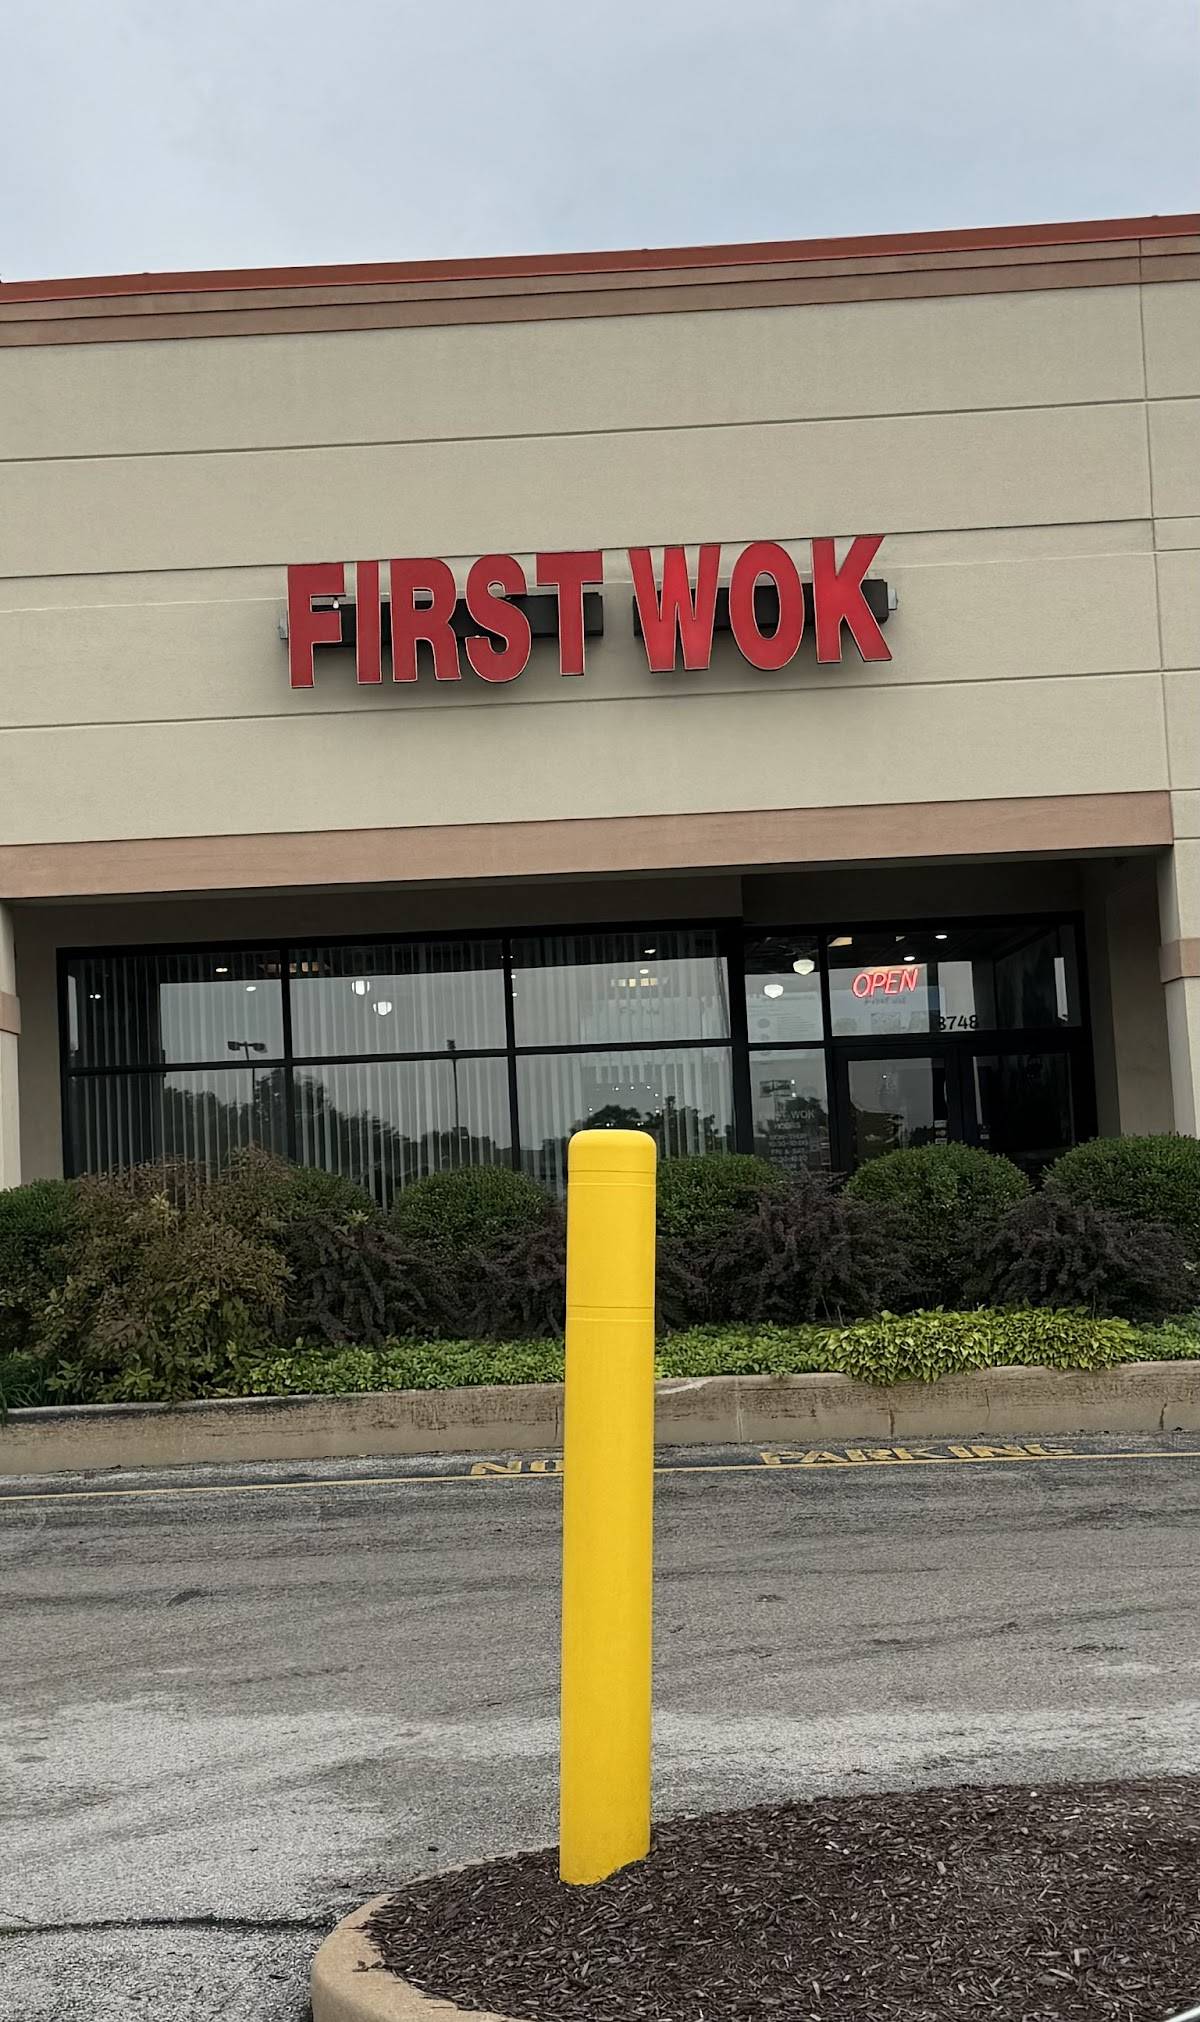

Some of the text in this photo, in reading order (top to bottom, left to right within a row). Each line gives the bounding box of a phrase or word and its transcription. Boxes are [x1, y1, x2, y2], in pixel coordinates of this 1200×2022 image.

[287, 534, 893, 688] FIRST WOK
[852, 967, 919, 998] OPEN
[759, 1444, 1074, 1465] PARKING
